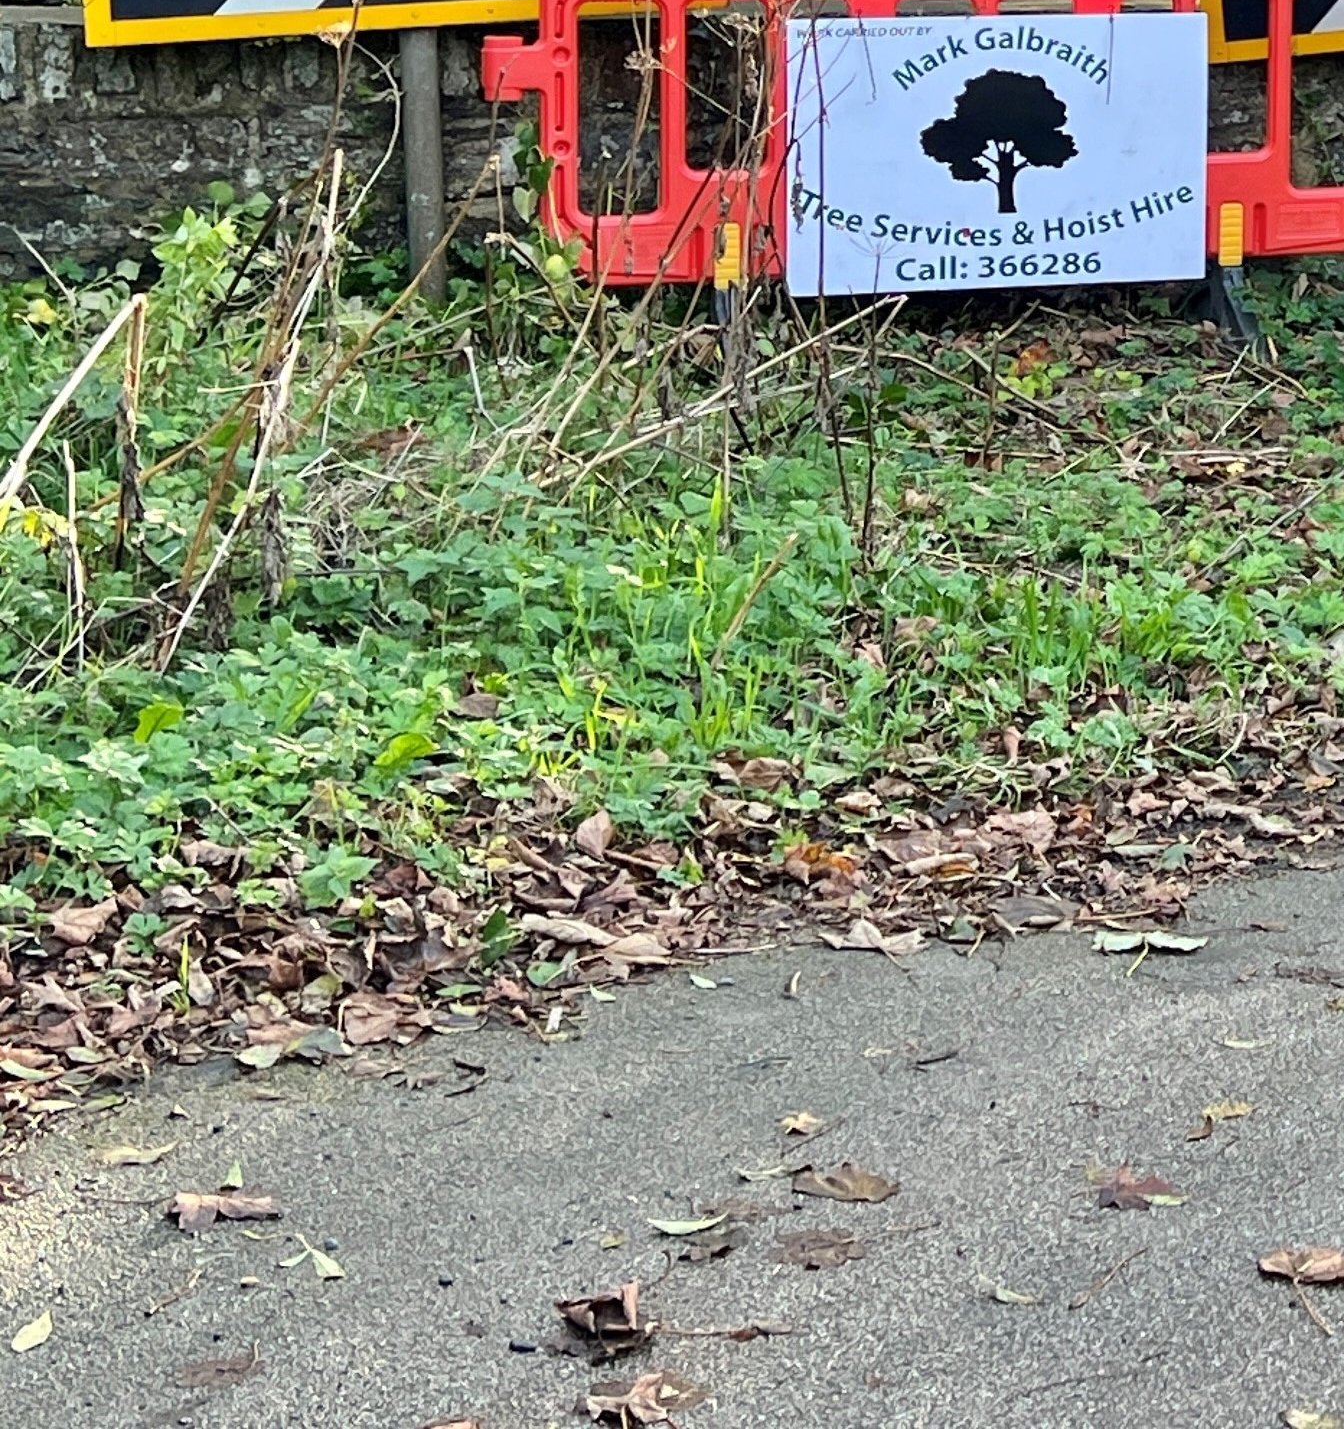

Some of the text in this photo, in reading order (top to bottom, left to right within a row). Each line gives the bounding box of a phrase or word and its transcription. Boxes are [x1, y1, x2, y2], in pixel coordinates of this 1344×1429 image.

[890, 26, 914, 37] OUT
[916, 26, 932, 36] BY
[892, 25, 1109, 91] Mark Galbraith
[801, 184, 1195, 247] Tree Services & Hoist Hire
[895, 251, 1102, 282] Call: 366286
